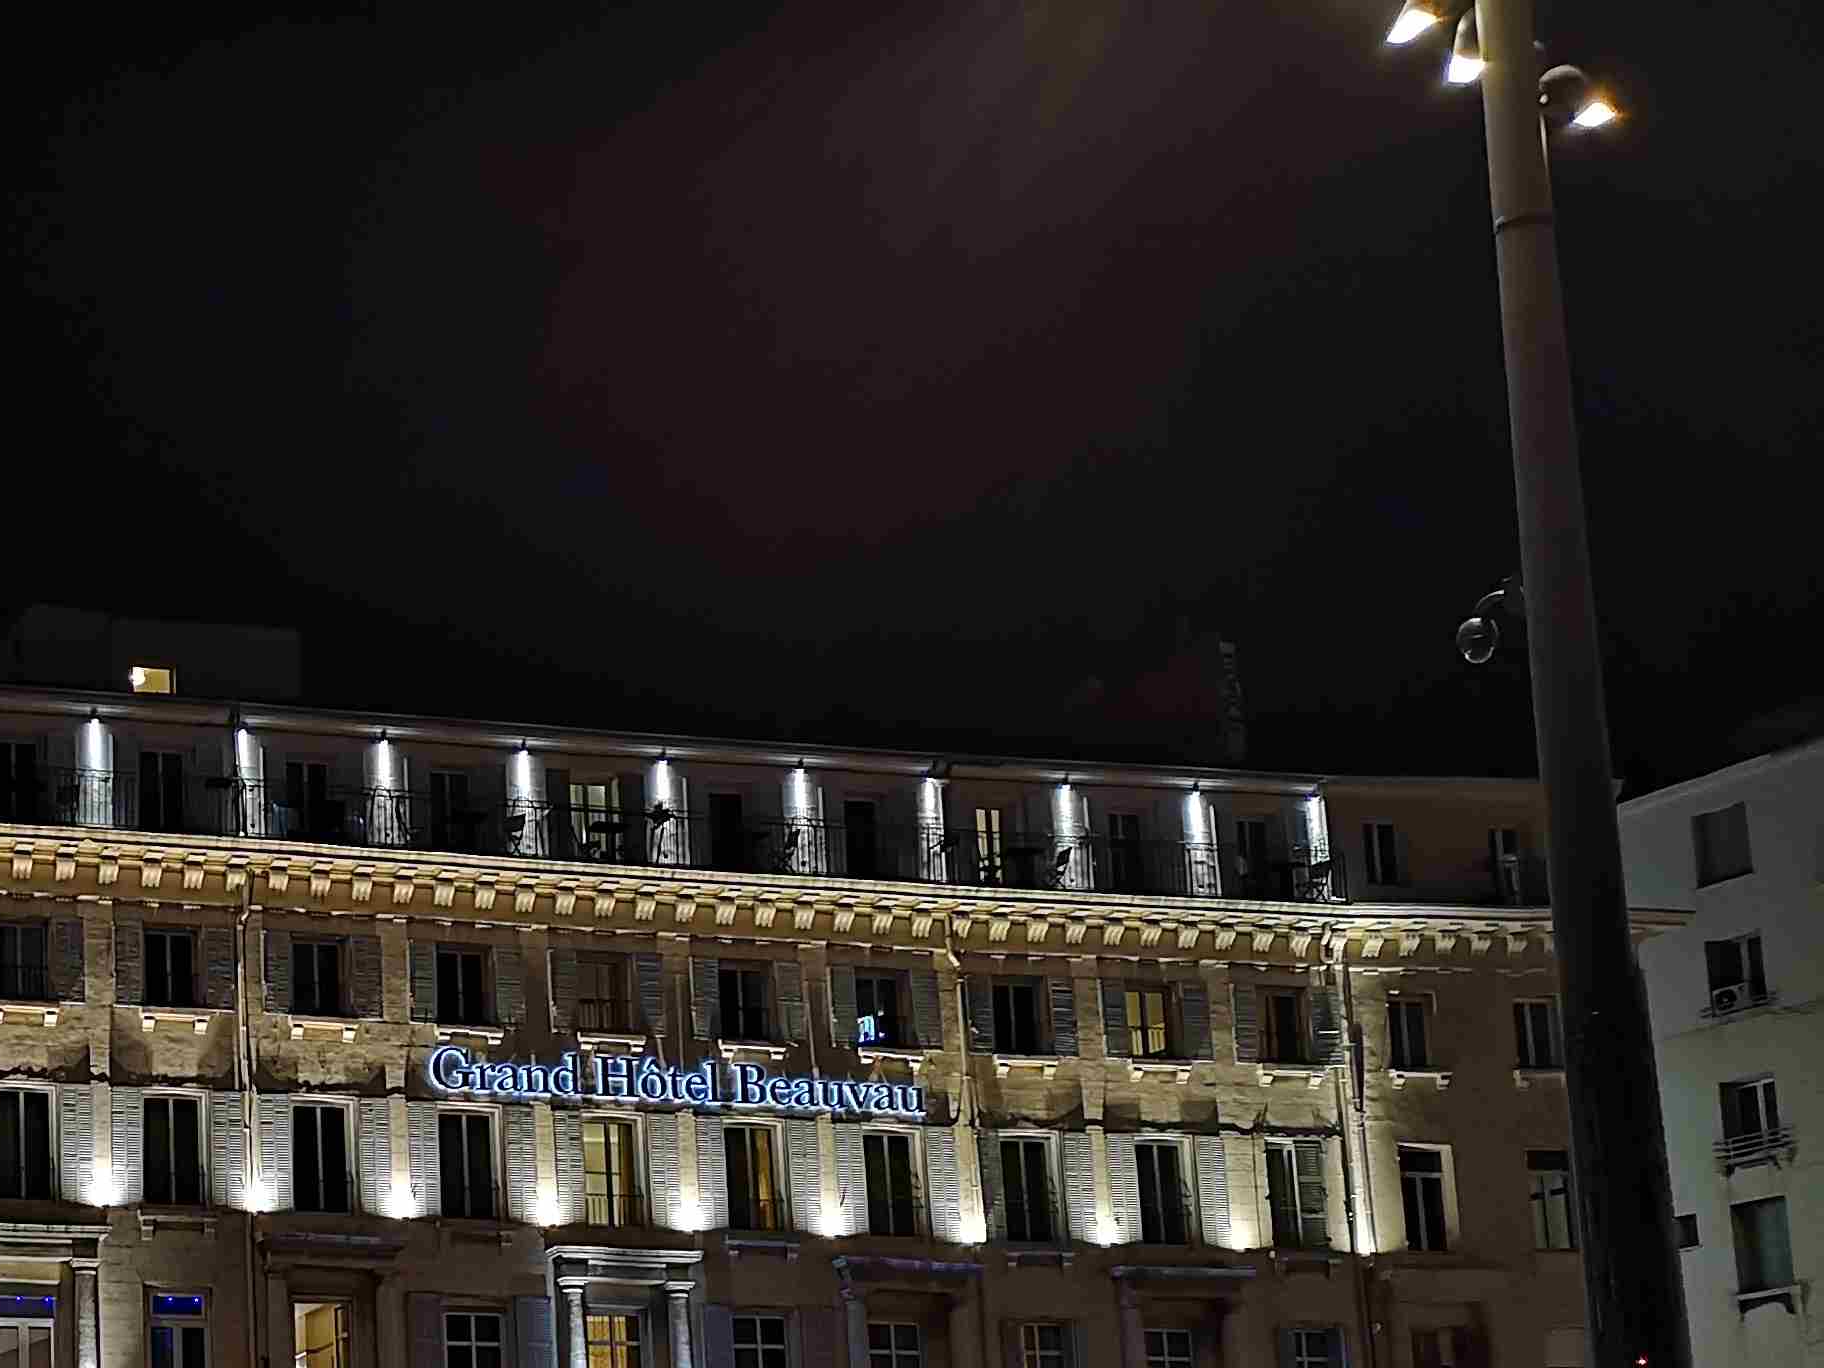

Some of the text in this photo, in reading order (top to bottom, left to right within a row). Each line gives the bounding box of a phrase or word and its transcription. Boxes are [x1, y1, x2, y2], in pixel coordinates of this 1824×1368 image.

[428, 1046, 927, 1115] Grand Hôtel Beauvau
